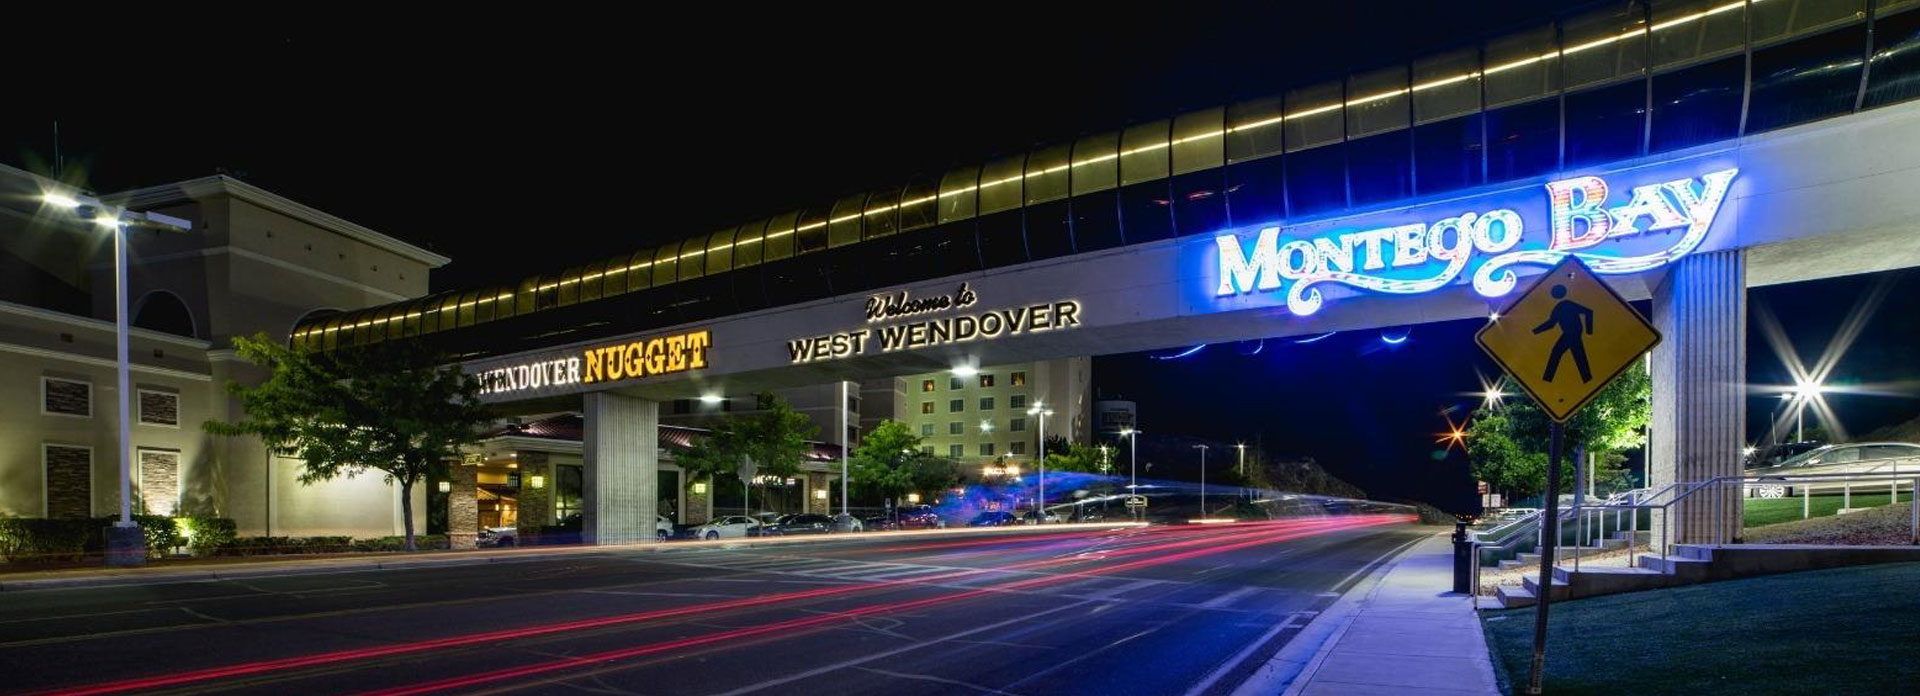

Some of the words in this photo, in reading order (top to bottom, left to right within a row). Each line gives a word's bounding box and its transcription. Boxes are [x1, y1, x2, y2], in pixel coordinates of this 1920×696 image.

[1545, 167, 1740, 273] BAY
[786, 330, 870, 363] WEST
[877, 300, 1081, 351] WENDOVER
[864, 289, 951, 323] Welcome
[953, 281, 977, 307] to
[476, 355, 581, 396] WENDOVER
[584, 329, 712, 384] NUGGET
